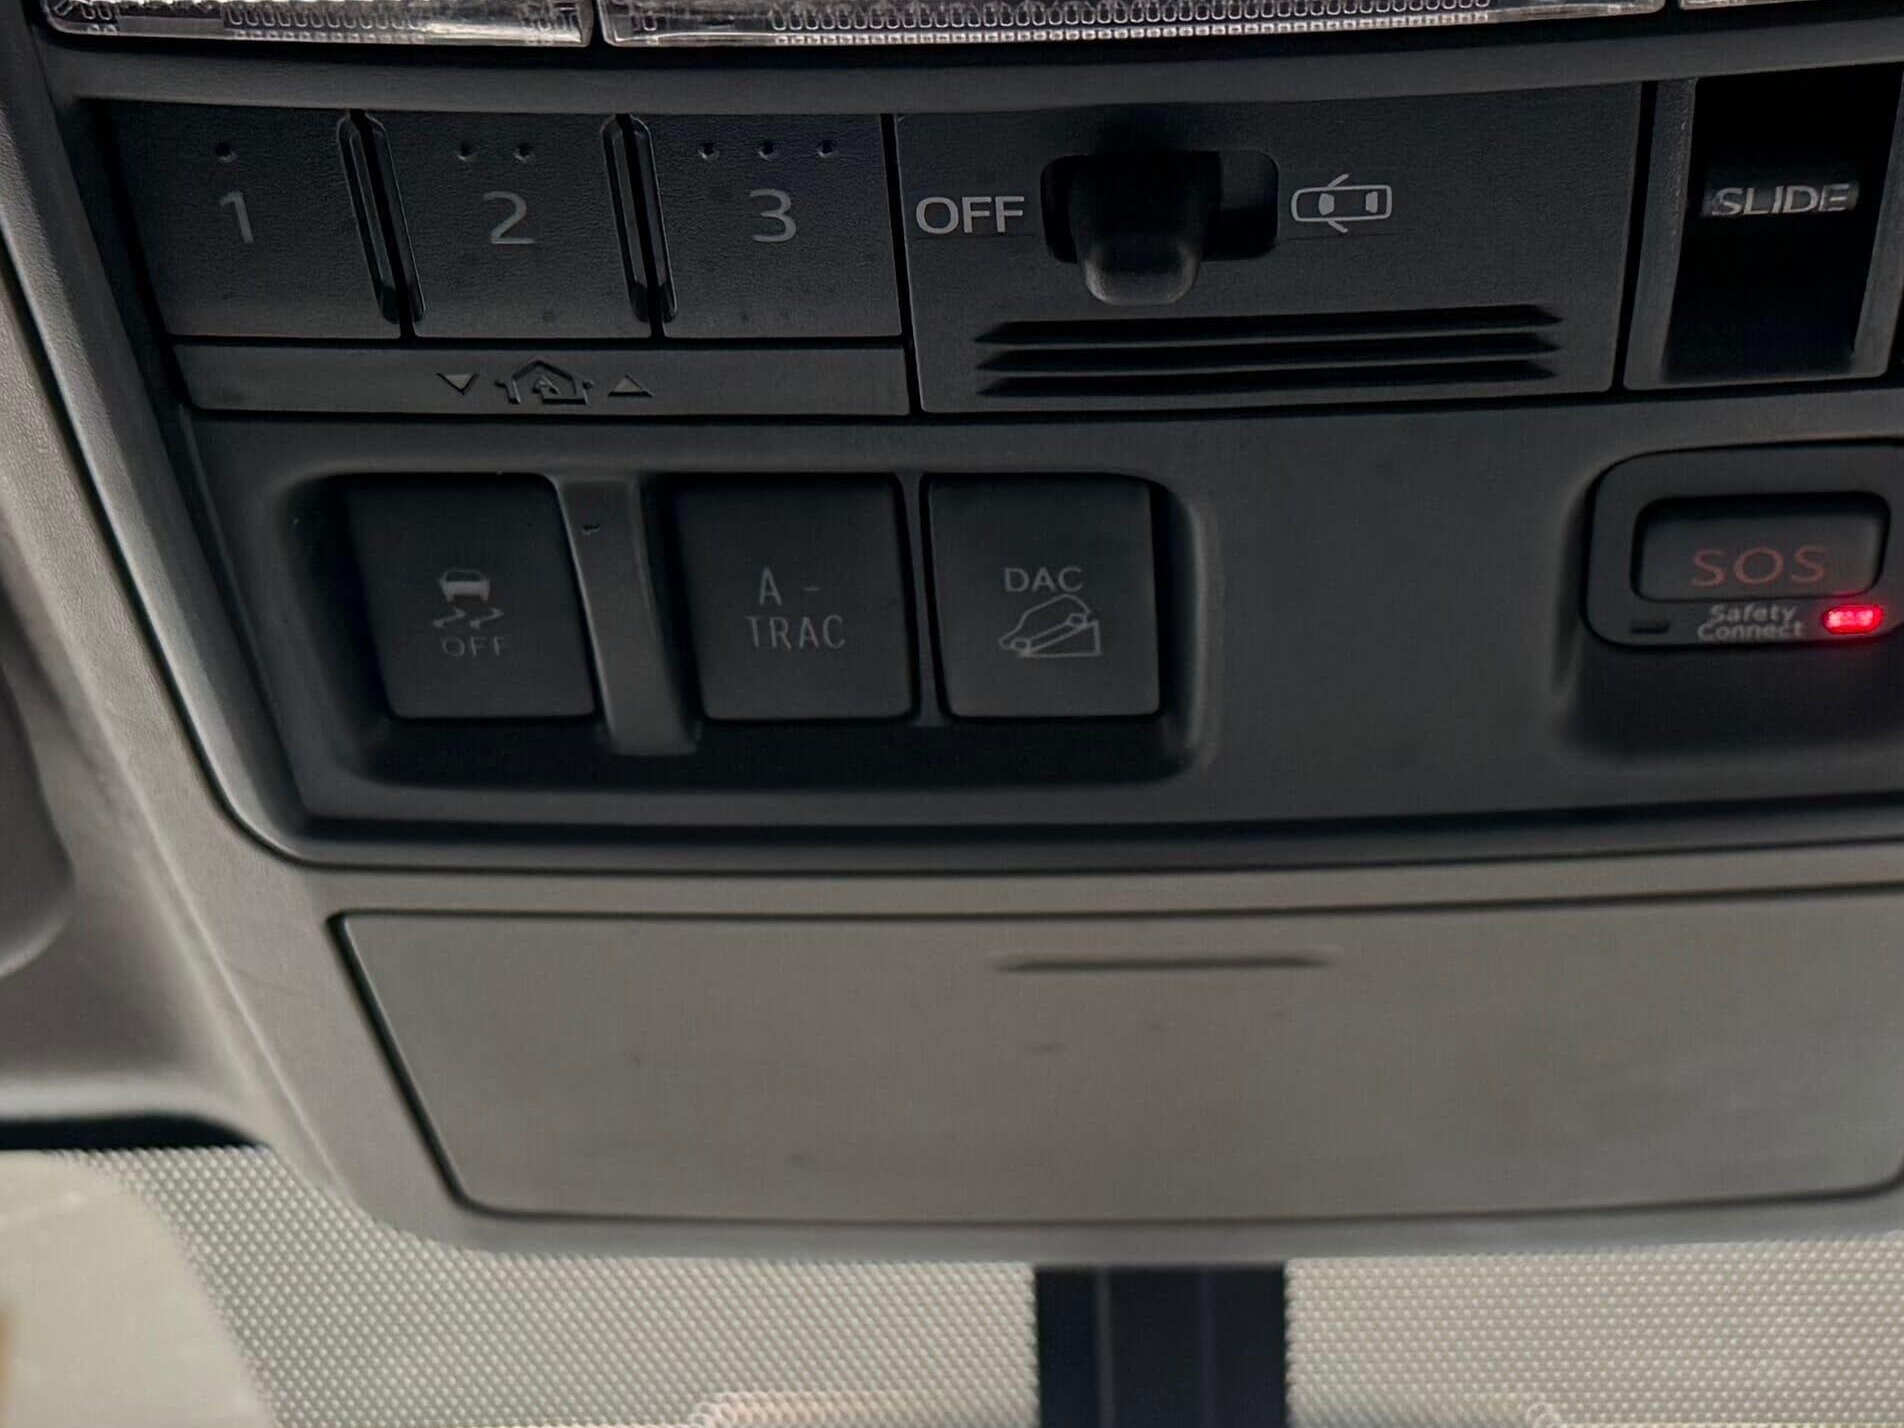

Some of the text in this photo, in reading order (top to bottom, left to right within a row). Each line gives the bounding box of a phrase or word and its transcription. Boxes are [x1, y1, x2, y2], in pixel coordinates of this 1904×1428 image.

[218, 188, 255, 245] 1
[482, 189, 537, 246] 2
[749, 187, 798, 244] 3
[915, 195, 1026, 236] OFF
[1710, 182, 1852, 218] SLIDE
[1003, 565, 1085, 594] DAC
[1689, 544, 1831, 589] SOS
[744, 613, 847, 650] TRAC
[1696, 620, 1804, 642] Connect
[1708, 603, 1797, 624] Safety
[441, 635, 509, 658] OFF
